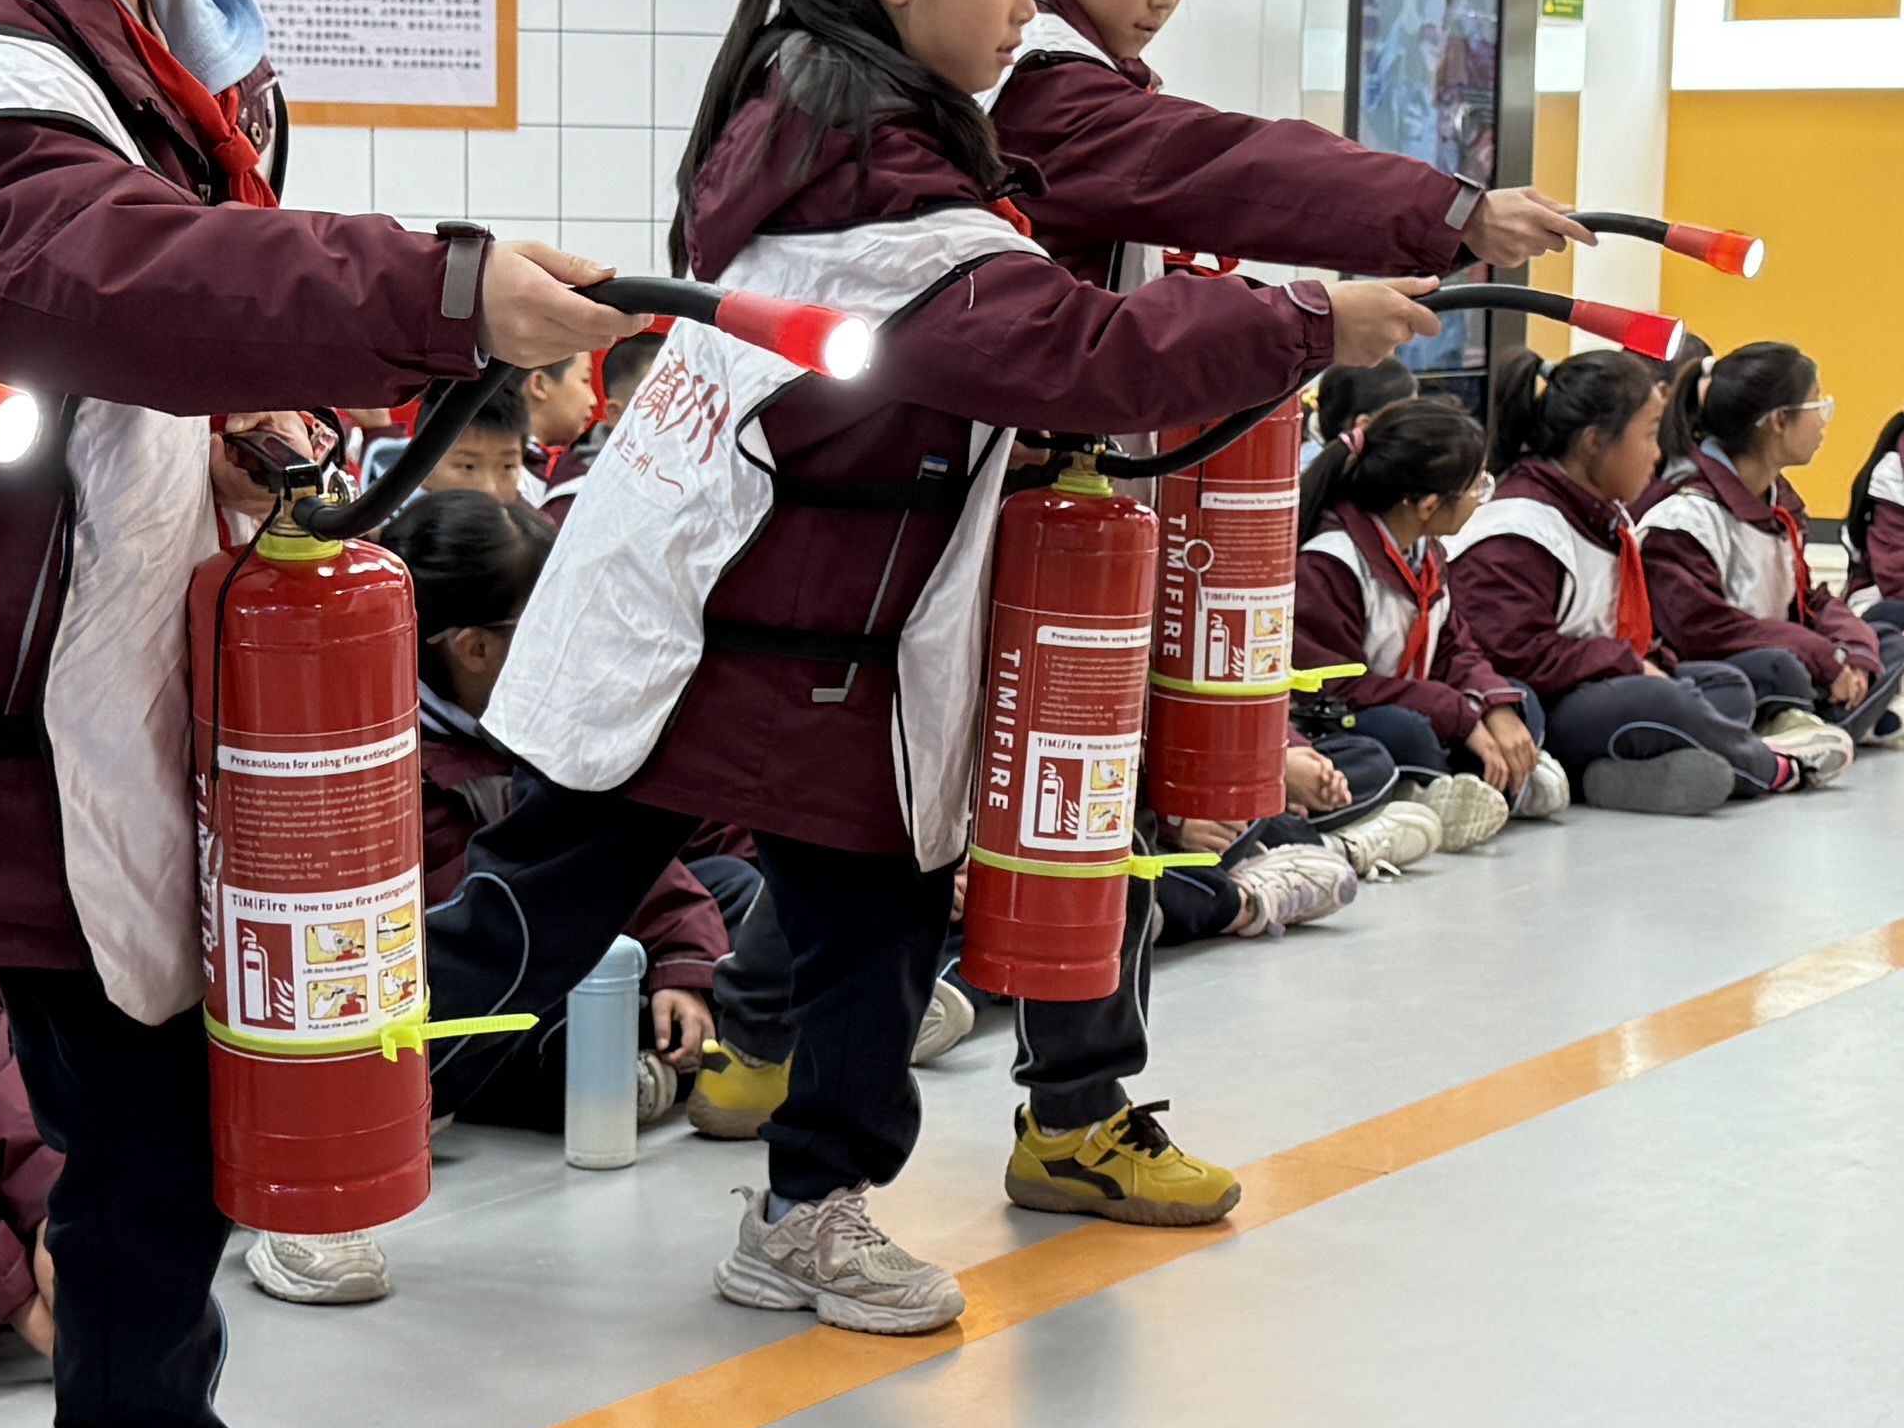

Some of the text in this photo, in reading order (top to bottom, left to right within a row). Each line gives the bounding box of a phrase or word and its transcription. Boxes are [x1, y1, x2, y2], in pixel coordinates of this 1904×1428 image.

[1162, 515, 1187, 659] TIMIFIRE
[231, 755, 291, 770] Precautions
[293, 759, 308, 769] for
[344, 755, 361, 765] fire
[989, 649, 1021, 812] TIMIFIRE
[294, 903, 319, 912] How
[321, 902, 332, 910] to
[335, 899, 353, 909] use
[356, 895, 373, 905] fire
